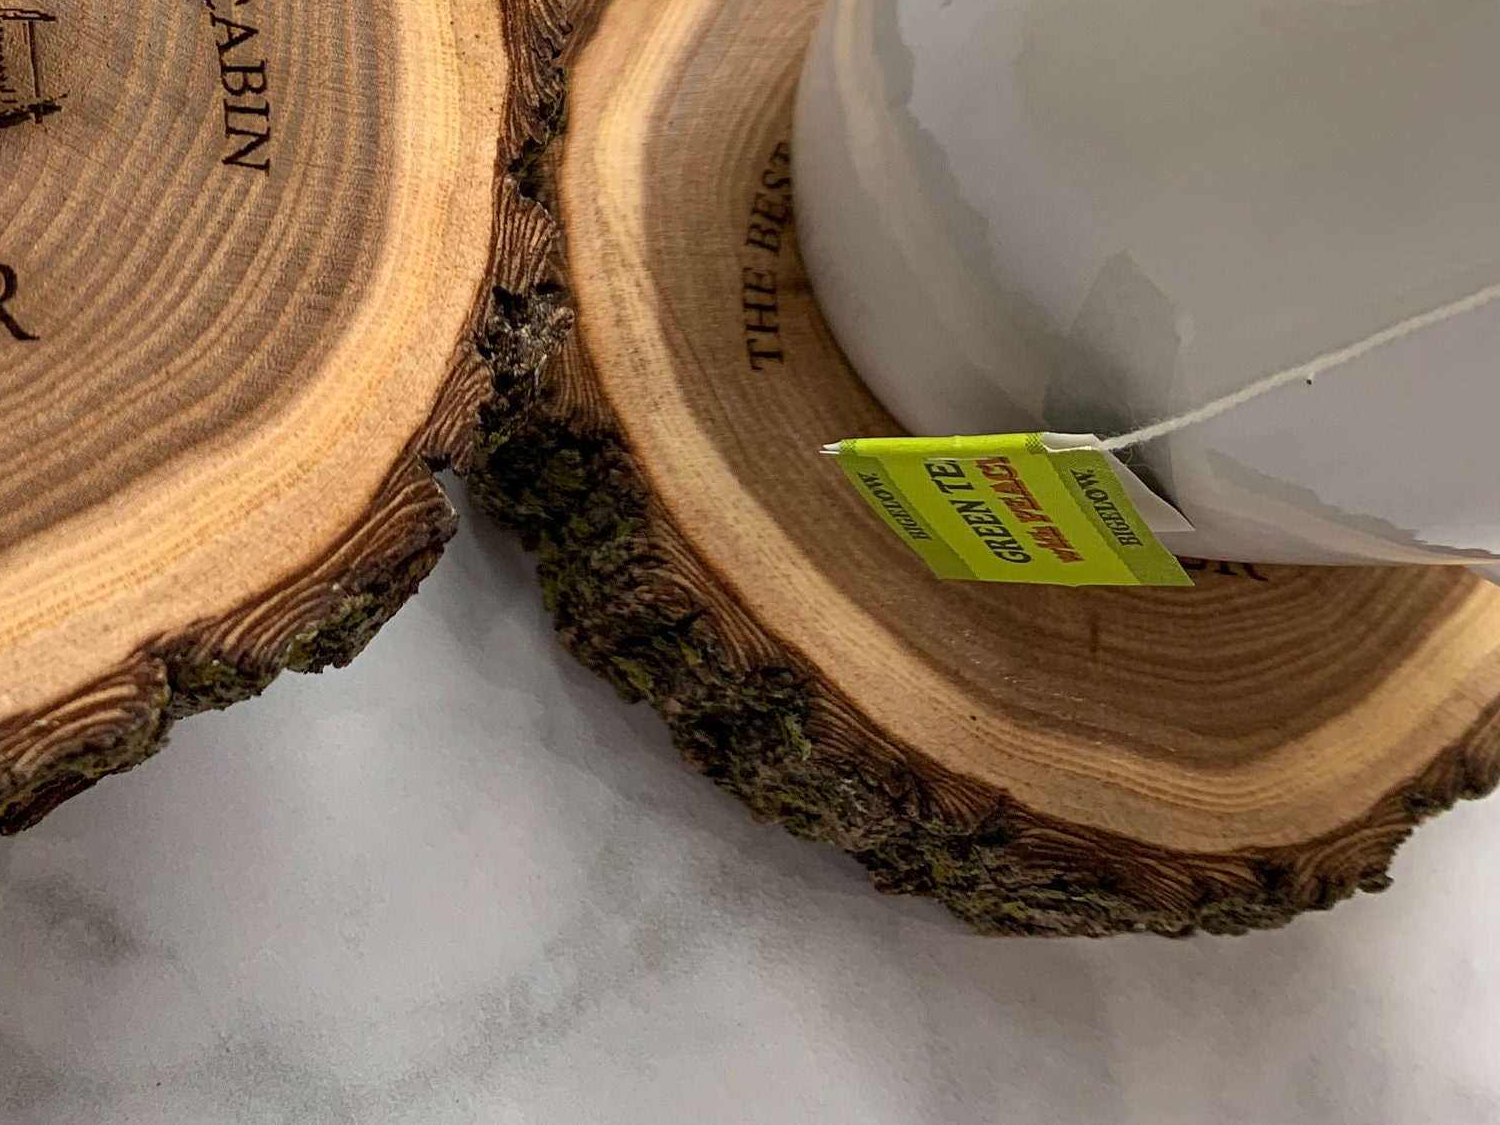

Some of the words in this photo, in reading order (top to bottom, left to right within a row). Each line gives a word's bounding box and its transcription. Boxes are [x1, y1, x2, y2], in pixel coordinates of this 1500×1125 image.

[743, 267, 785, 371] THE
[924, 459, 975, 494] TE
[948, 499, 1032, 563] GREEN
